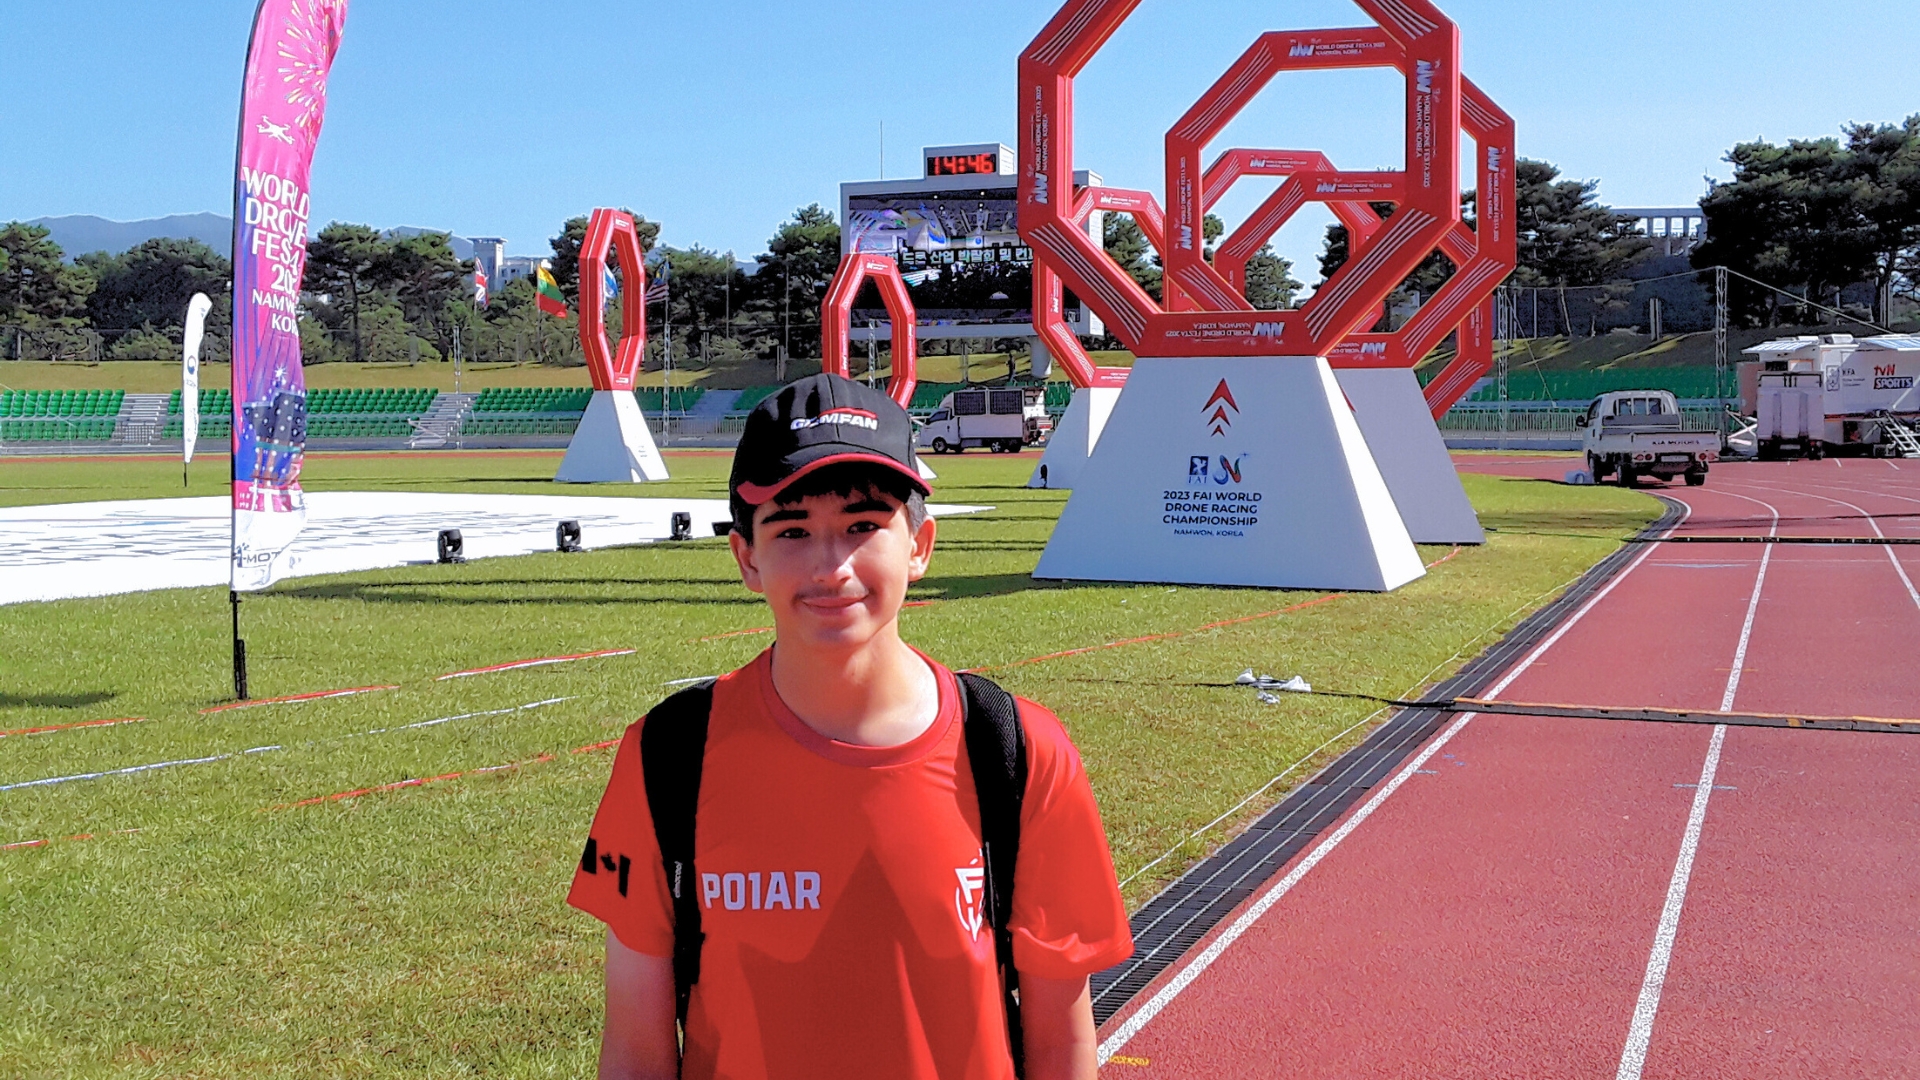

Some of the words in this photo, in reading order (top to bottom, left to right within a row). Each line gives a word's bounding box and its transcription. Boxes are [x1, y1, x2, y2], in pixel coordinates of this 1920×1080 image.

[934, 153, 994, 176] 14:46
[243, 166, 310, 220] WORLD
[252, 228, 300, 275] FESA
[903, 251, 926, 265] 드론
[930, 250, 954, 264] 산업
[958, 249, 995, 263] 박람회
[999, 248, 1011, 261] 및
[1015, 247, 1033, 260] 컨
[1874, 364, 1895, 376] tvN
[1875, 378, 1911, 389] SPORTS
[1163, 490, 1190, 500] 2023
[1193, 492, 1212, 501] FAI
[1215, 492, 1262, 502] WORLD
[1165, 503, 1208, 512] DRONE
[1211, 504, 1257, 514] RACING
[1162, 515, 1258, 526] CHAMPIONSHIP
